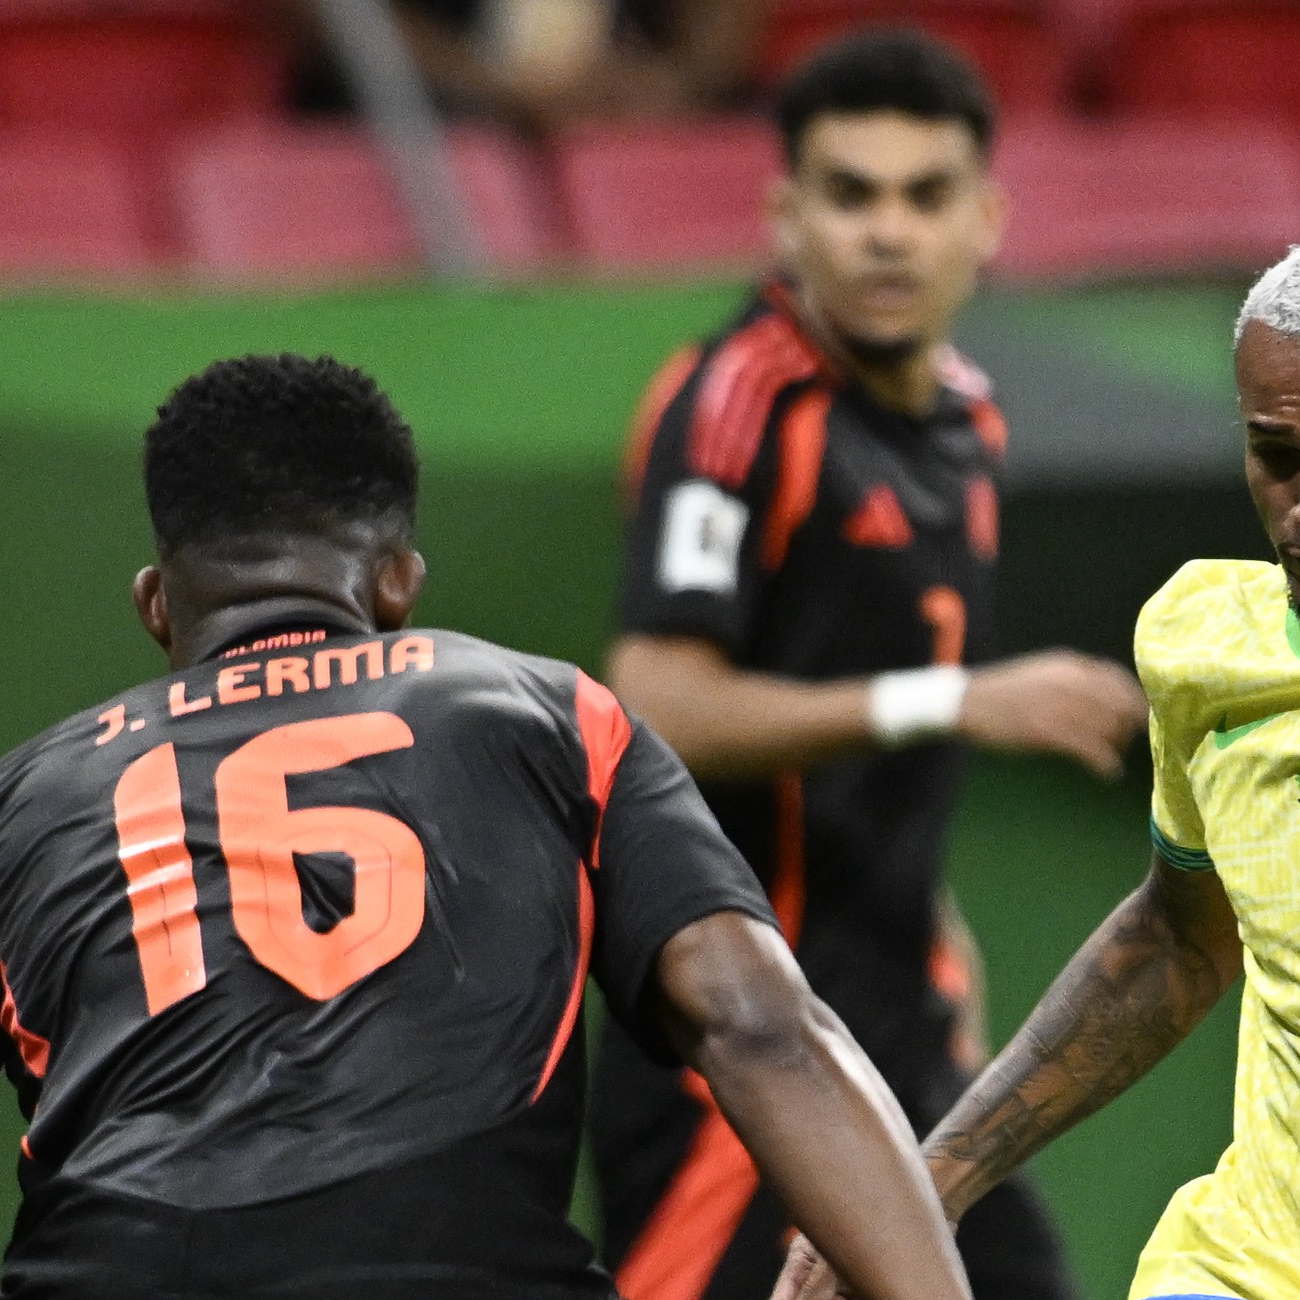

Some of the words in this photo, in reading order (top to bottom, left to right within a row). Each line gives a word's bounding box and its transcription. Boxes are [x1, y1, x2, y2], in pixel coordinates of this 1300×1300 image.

[95, 703, 146, 746] J.
[168, 635, 435, 717] LERMA
[113, 711, 427, 1018] 16
